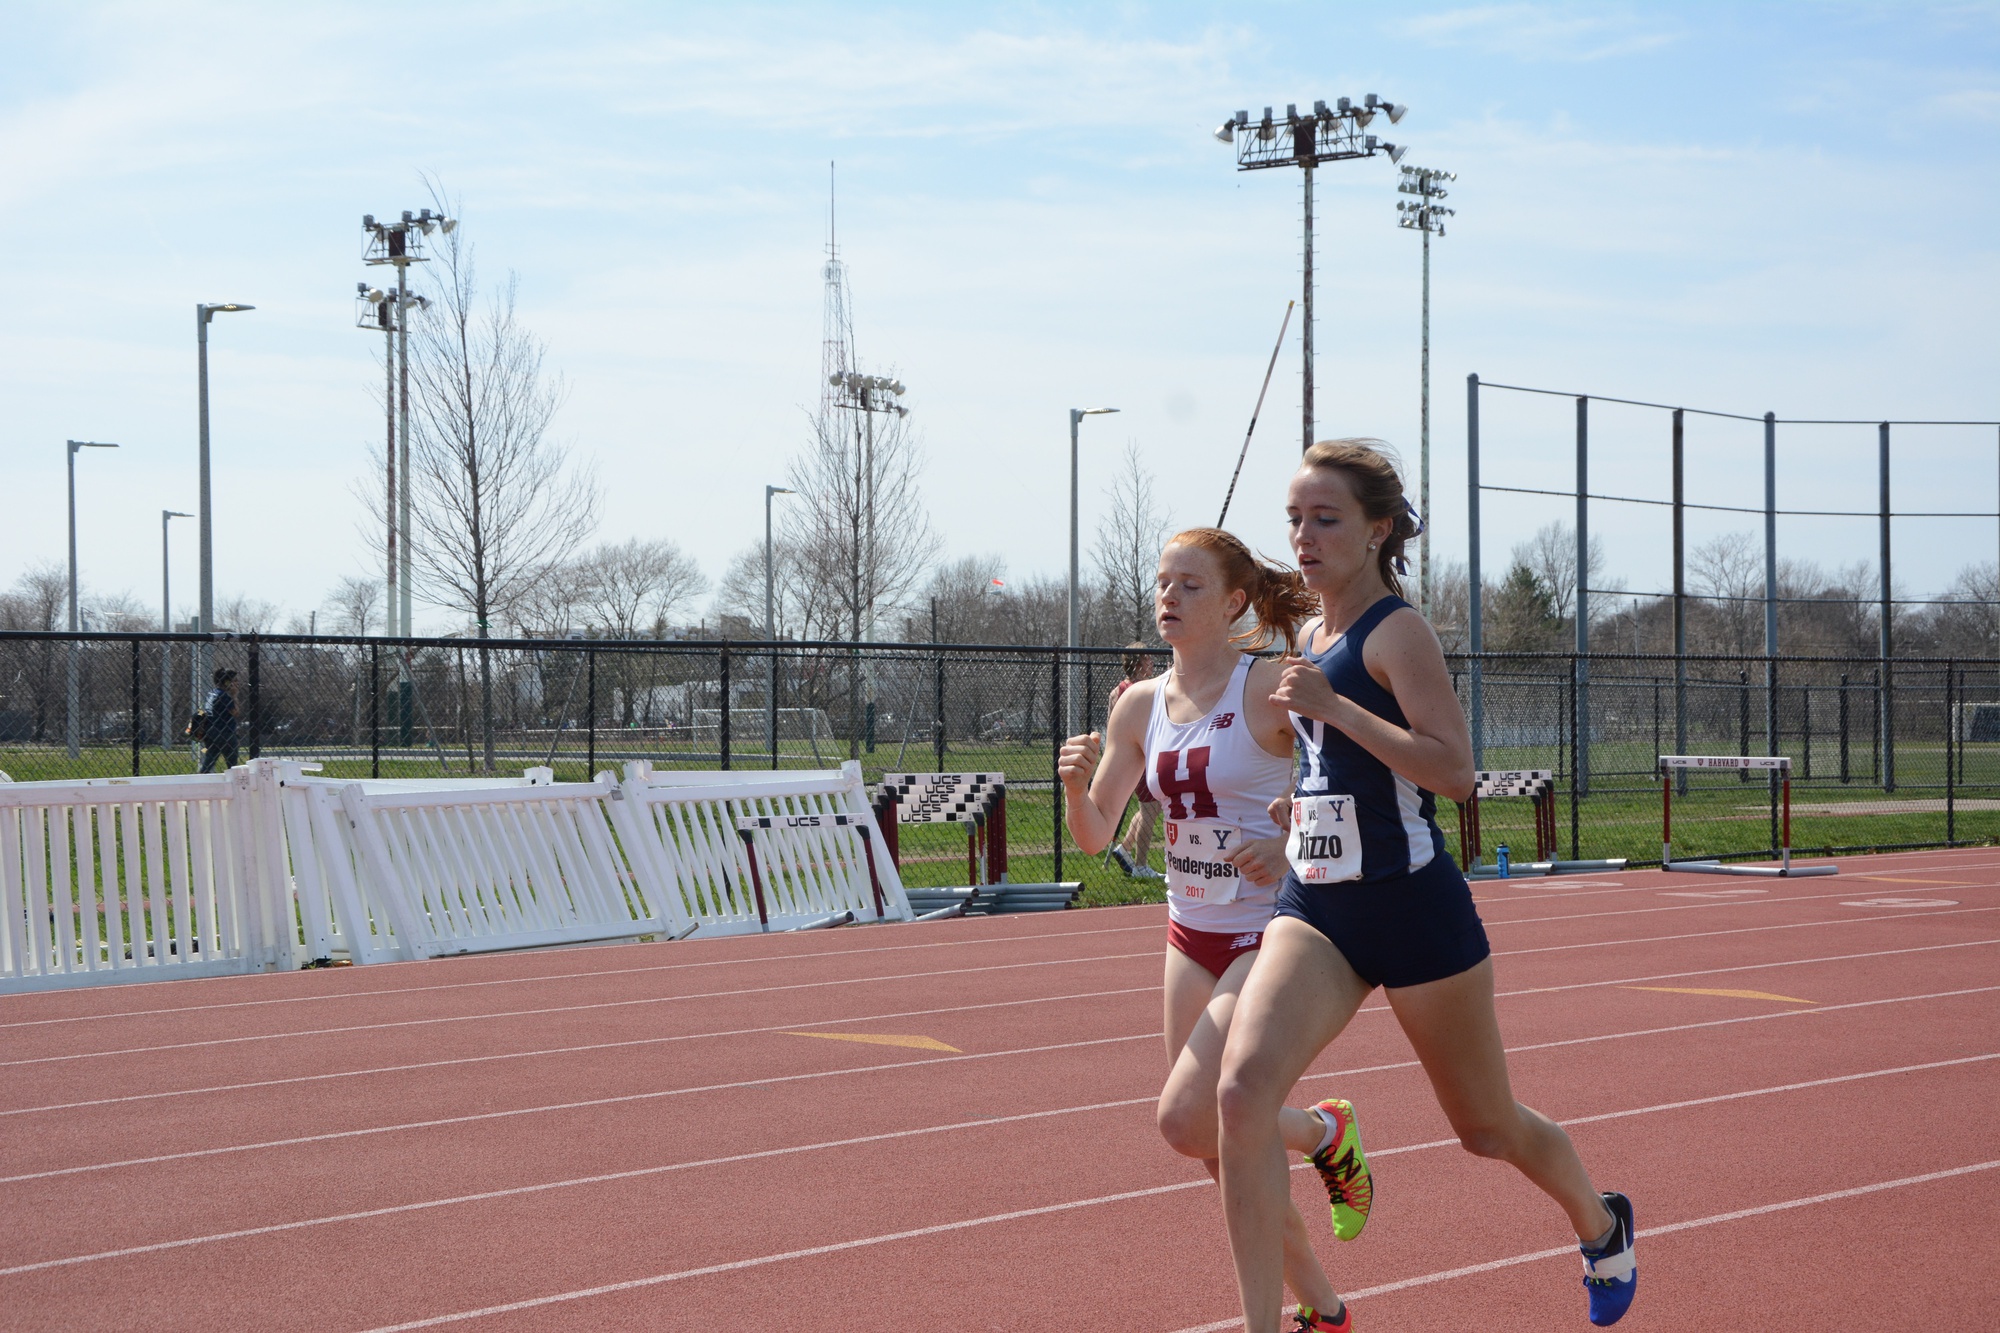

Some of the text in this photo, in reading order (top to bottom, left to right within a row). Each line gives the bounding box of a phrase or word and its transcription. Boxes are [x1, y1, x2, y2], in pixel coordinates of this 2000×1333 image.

[1288, 710, 1329, 792] Y
[1708, 758, 1739, 767] HARVARD
[931, 775, 961, 785] UCS
[1499, 772, 1522, 781] UCS
[1156, 746, 1220, 820] H
[925, 785, 955, 794] UCS
[1487, 788, 1509, 796] UCS
[919, 794, 949, 804] UCS
[911, 803, 941, 813] UCS
[1328, 800, 1345, 822] Y
[786, 816, 821, 827] UCS
[901, 813, 932, 822] UCS
[1212, 829, 1232, 850] Y
[1297, 831, 1343, 860] Rizzo
[1167, 850, 1240, 880] Pendergast
[1305, 866, 1328, 880] 2017
[1185, 885, 1205, 899] 2017
